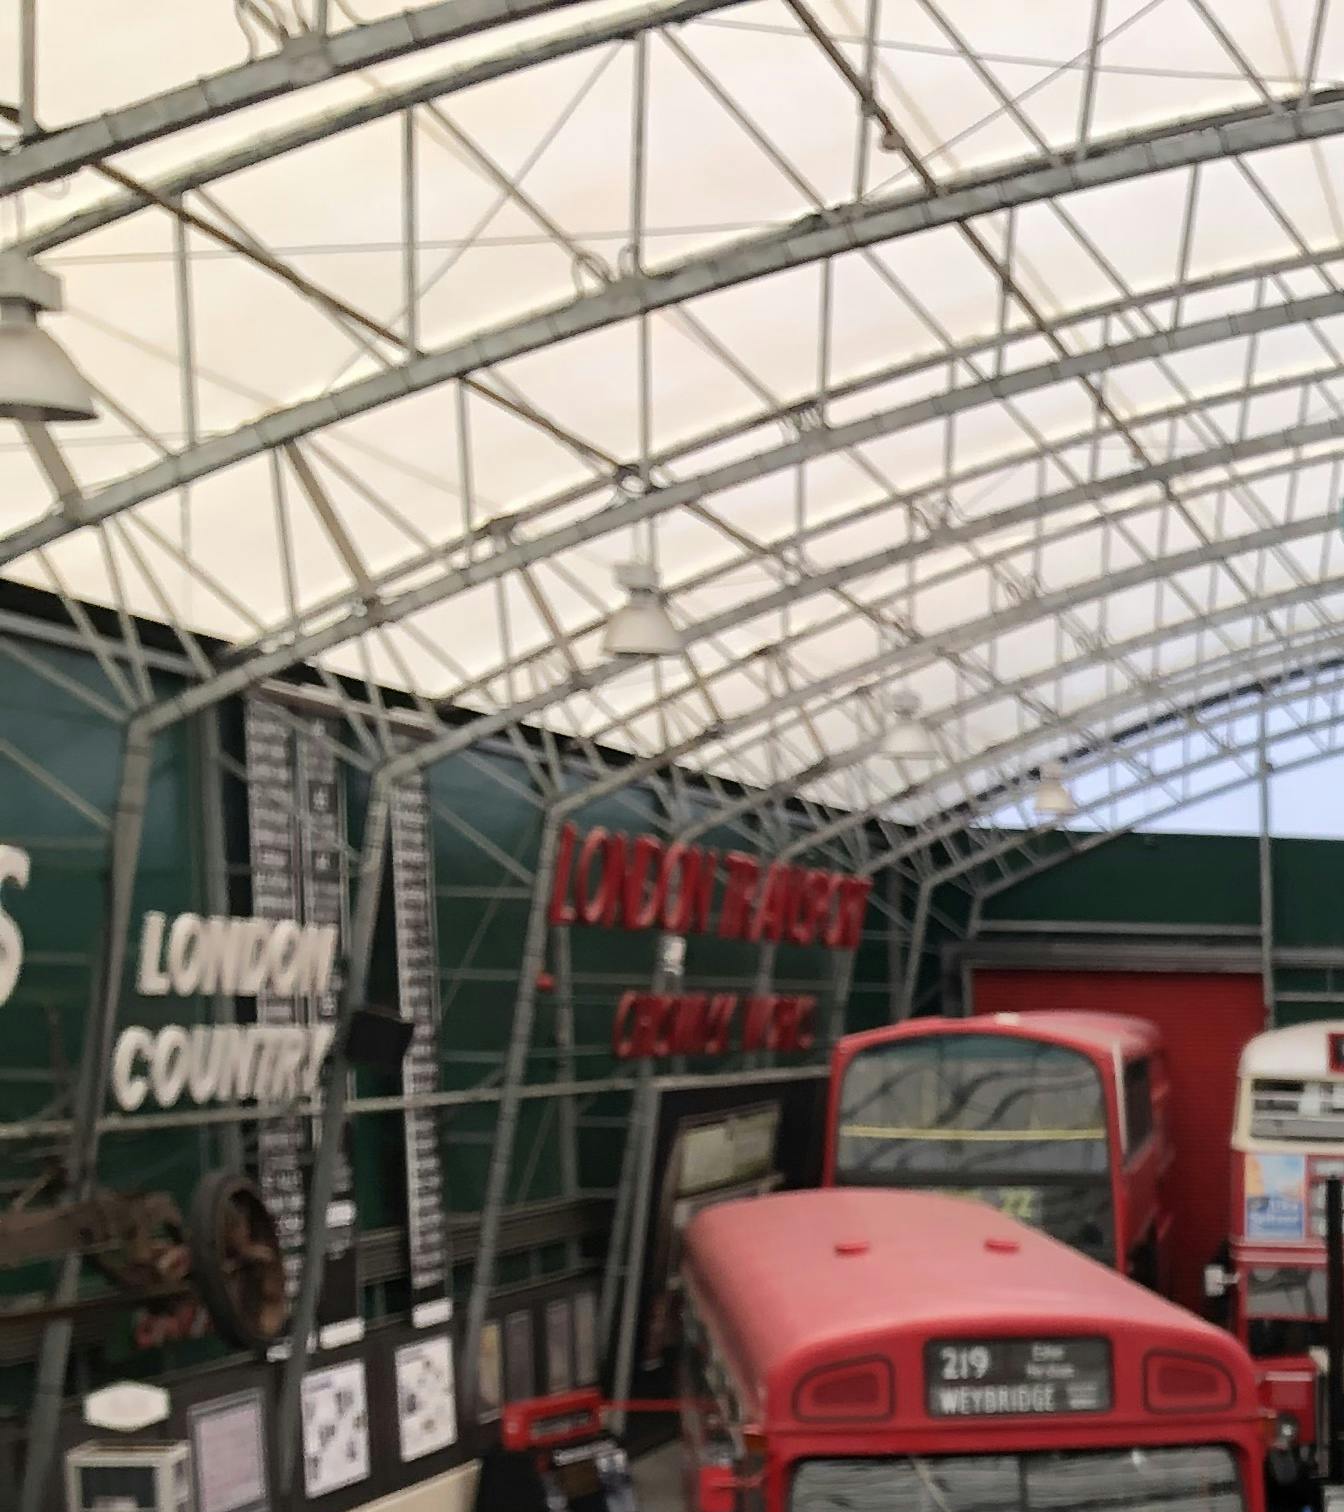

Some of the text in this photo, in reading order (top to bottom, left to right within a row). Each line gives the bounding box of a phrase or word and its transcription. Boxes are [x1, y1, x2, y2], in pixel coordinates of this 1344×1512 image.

[550, 820, 718, 936] LONDON
[136, 911, 338, 998] LONDON
[111, 1024, 337, 1112] COUNTRY
[939, 1383, 1055, 1414] WEYBRIDGE
[941, 1345, 991, 1380] 219
